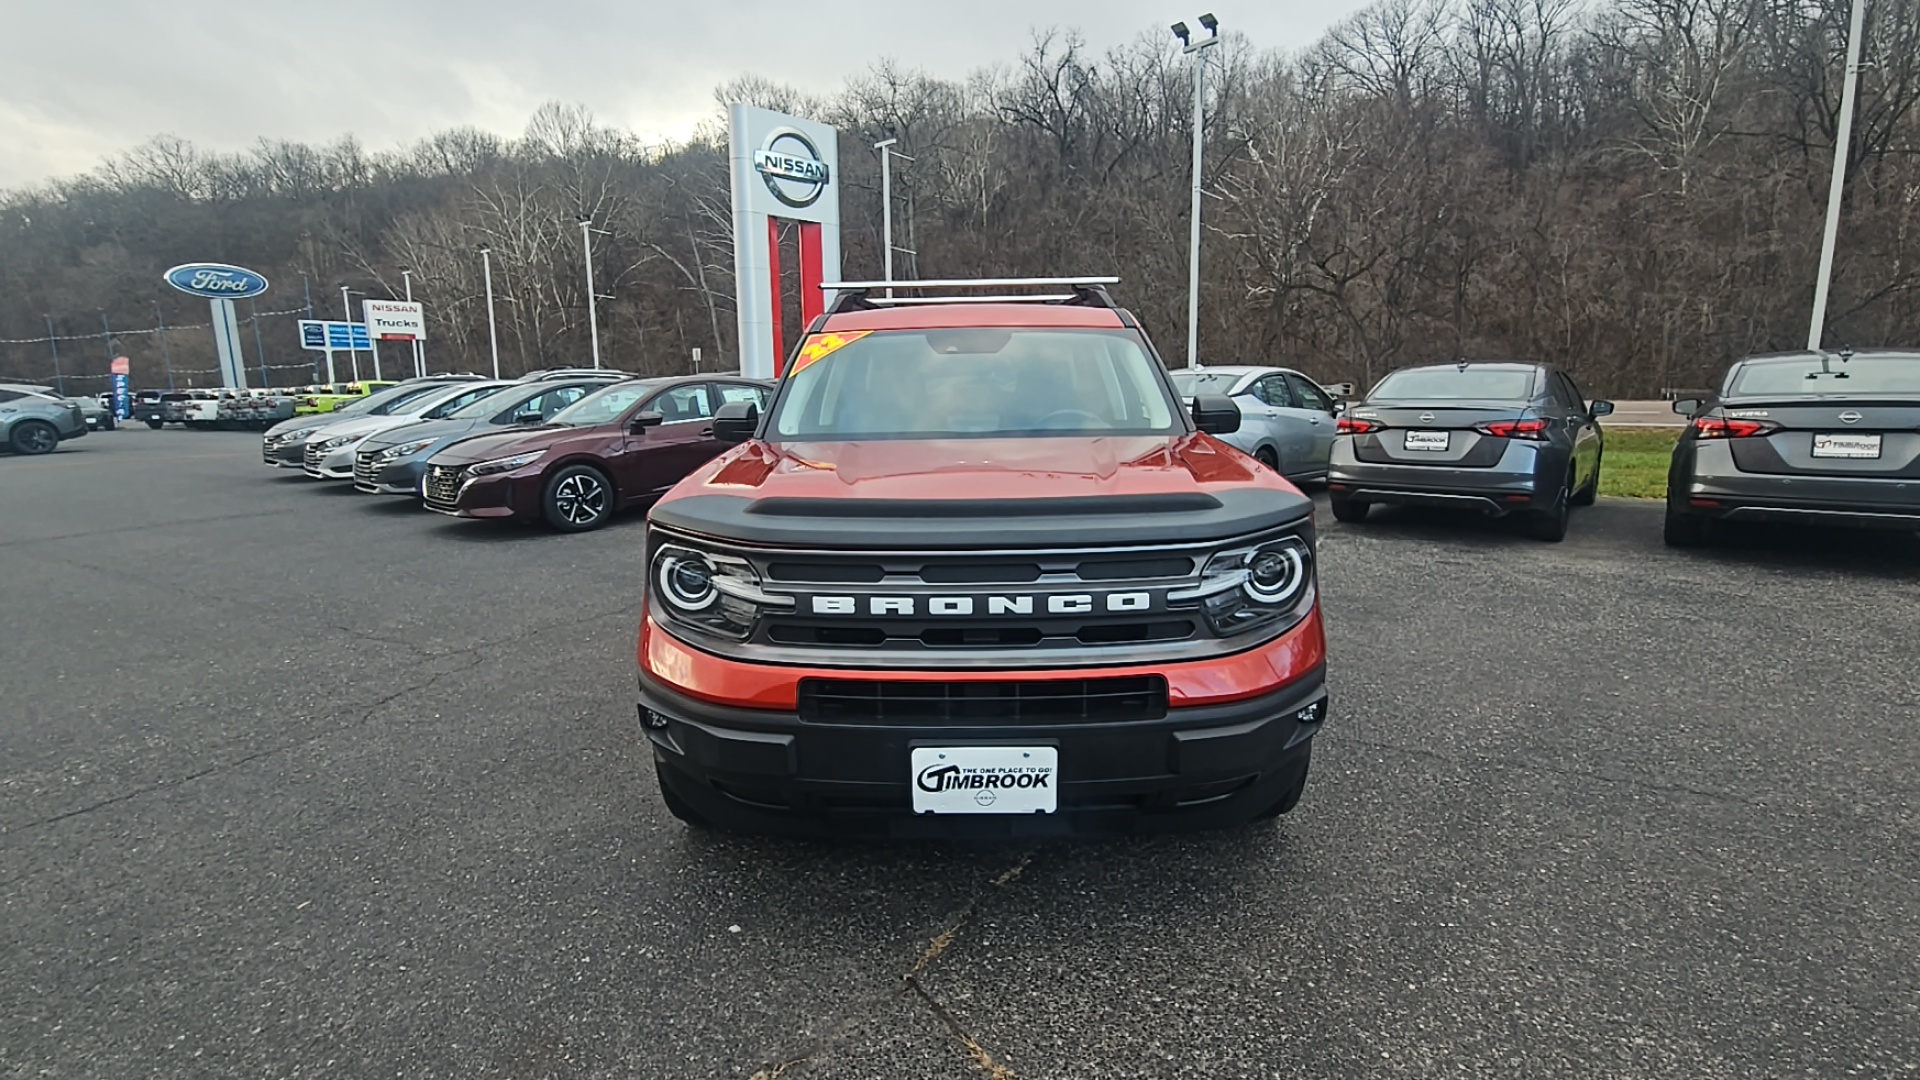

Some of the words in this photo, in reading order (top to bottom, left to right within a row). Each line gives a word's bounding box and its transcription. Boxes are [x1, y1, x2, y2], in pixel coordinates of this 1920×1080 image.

[765, 155, 825, 178] NISSAN
[191, 269, 248, 291] Ford
[372, 304, 418, 312] NISSAN
[375, 319, 418, 328] Trucks
[812, 592, 1151, 615] BRONCO
[916, 763, 1050, 793] TIMBROOK
